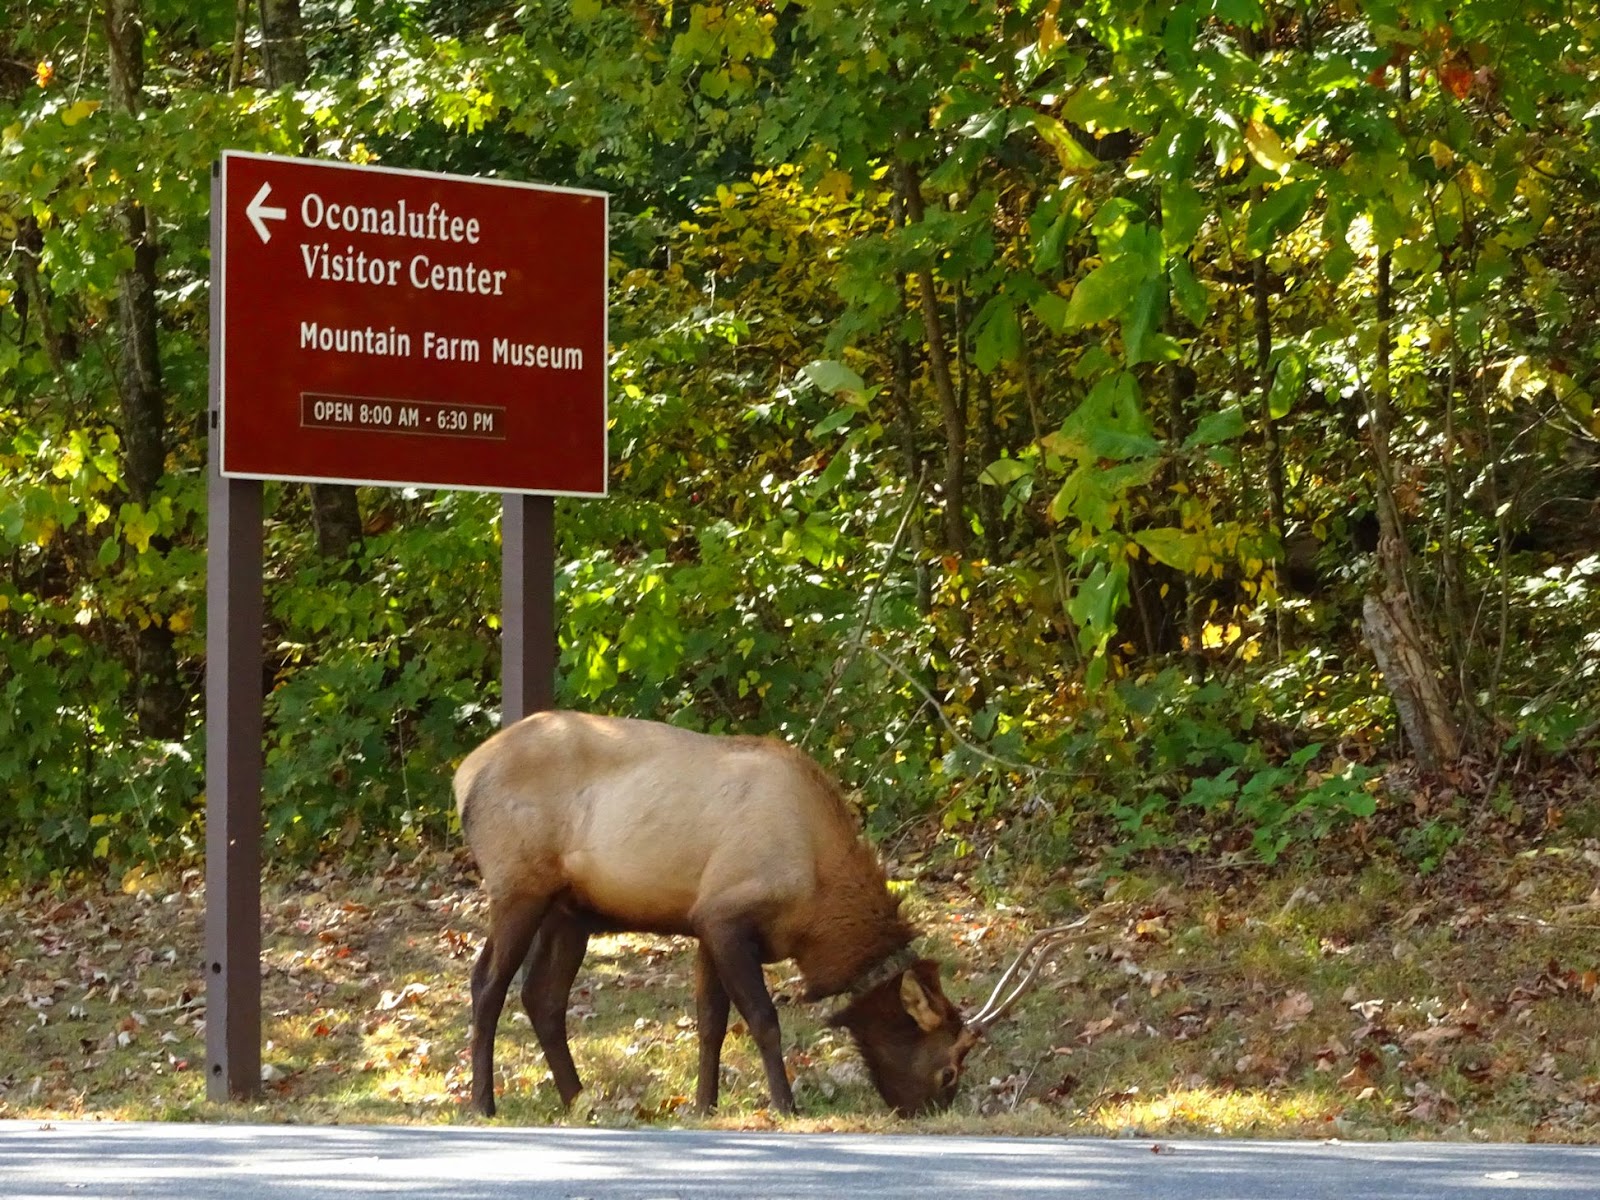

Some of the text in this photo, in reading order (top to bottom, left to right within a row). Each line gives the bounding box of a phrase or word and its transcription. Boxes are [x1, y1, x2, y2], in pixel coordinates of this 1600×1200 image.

[301, 193, 480, 244] Oconaluftee
[300, 243, 507, 296] Visitor Center
[300, 321, 583, 370] Mountain Farm Museum
[314, 400, 353, 423] OPEN
[359, 406, 392, 426] 8:00
[398, 408, 419, 428] AM
[437, 411, 468, 431] 6:30
[473, 412, 493, 432] PM
